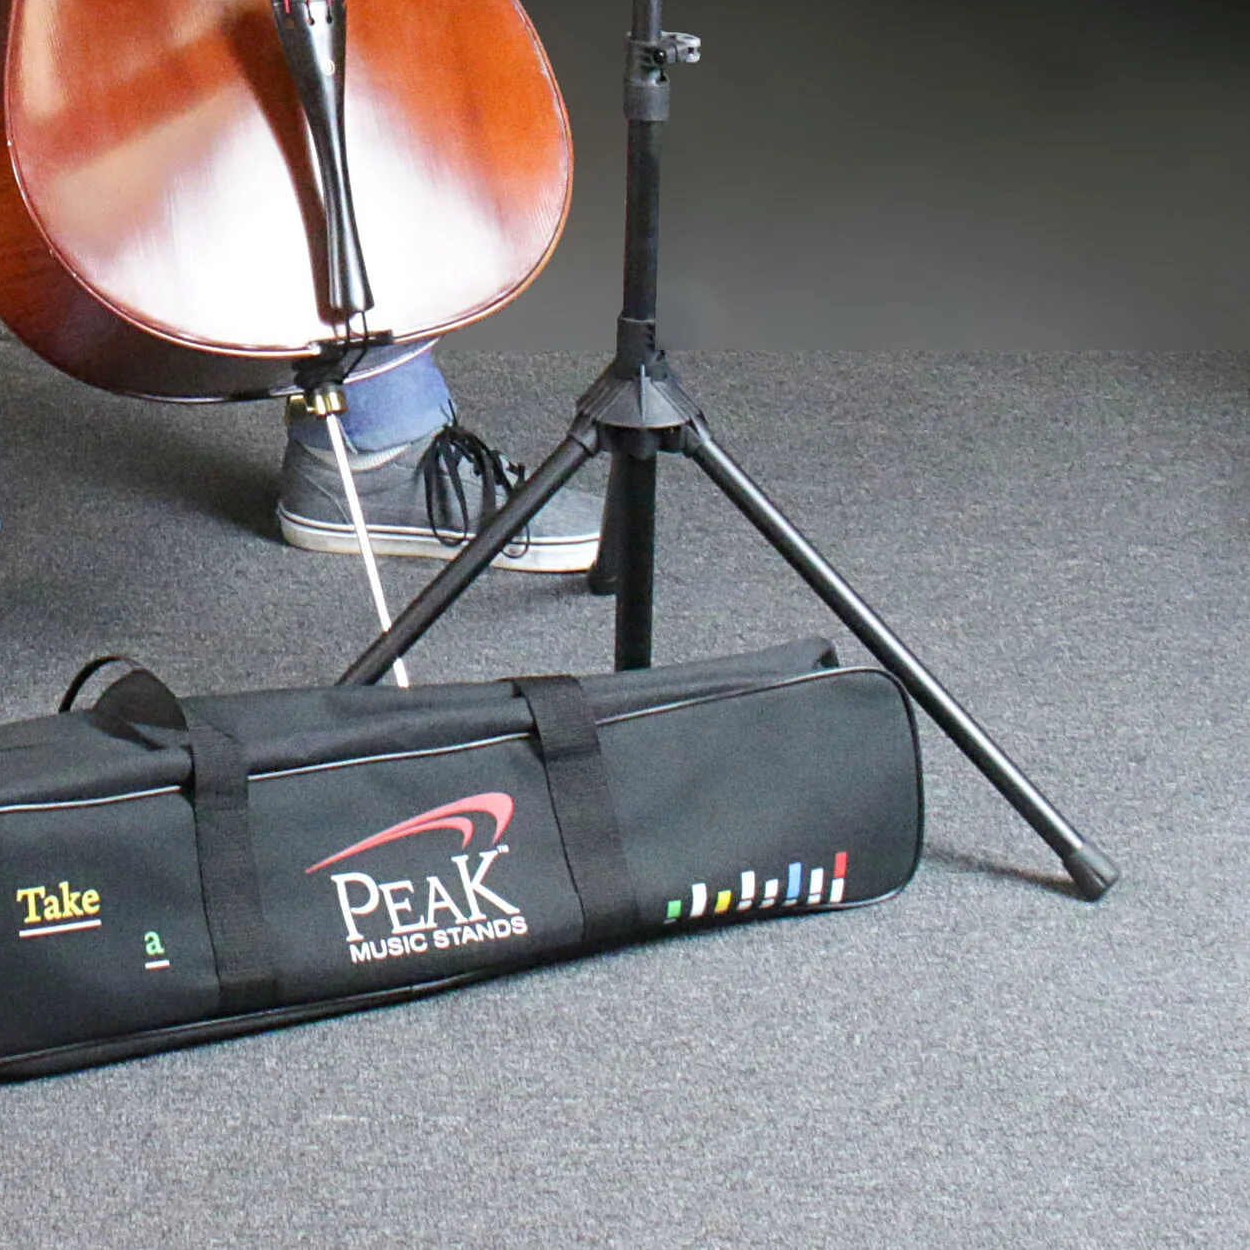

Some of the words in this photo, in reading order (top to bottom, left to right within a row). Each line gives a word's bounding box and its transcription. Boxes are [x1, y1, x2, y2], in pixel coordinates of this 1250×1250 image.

[16, 881, 101, 923] Take
[144, 930, 166, 956] a
[349, 933, 428, 963] MUSIC
[433, 915, 528, 949] STANDS
